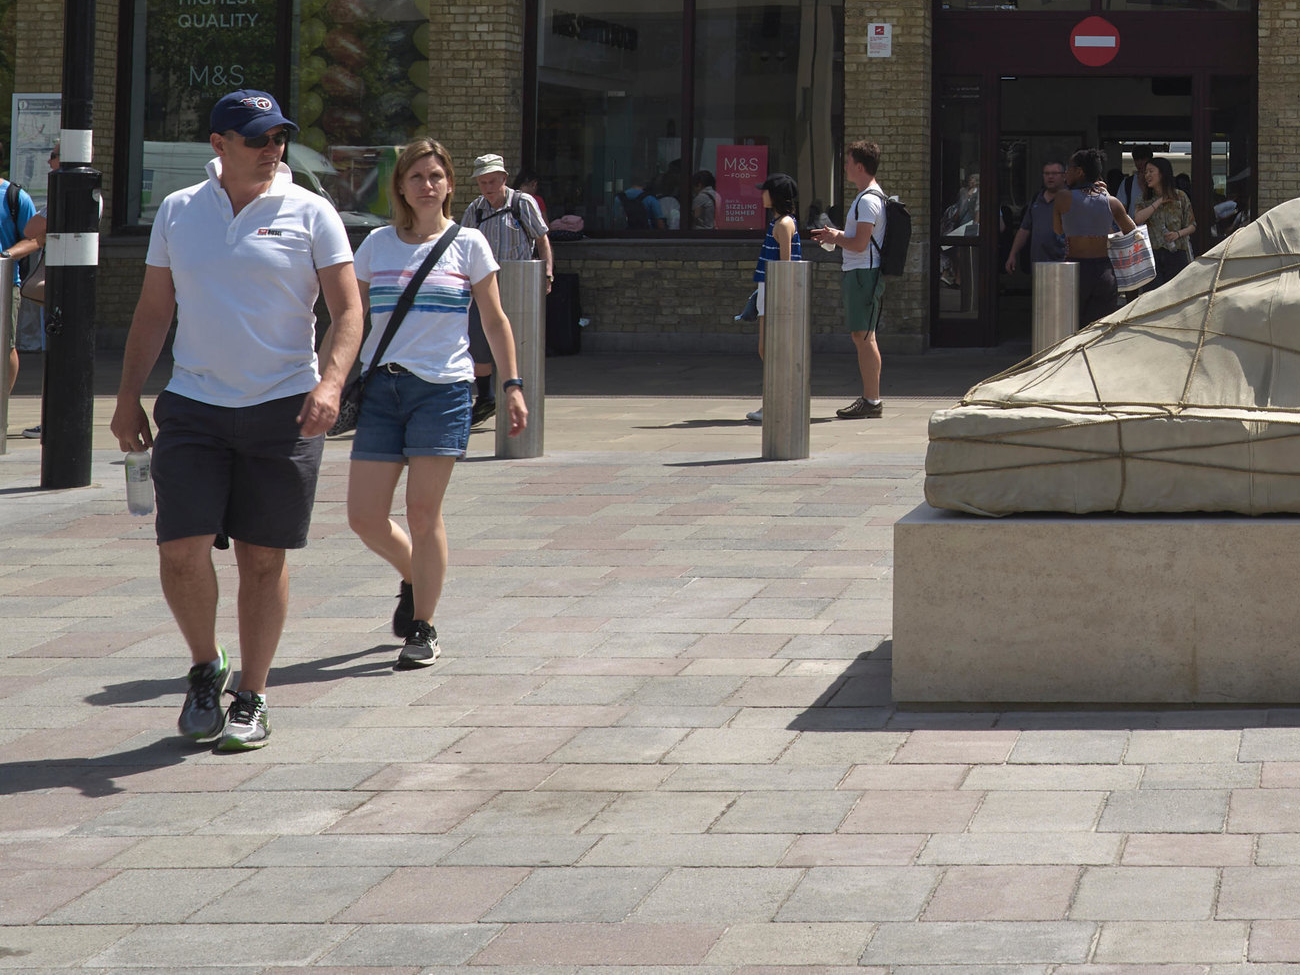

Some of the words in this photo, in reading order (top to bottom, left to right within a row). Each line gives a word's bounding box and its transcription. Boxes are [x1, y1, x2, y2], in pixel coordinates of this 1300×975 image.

[178, 13, 259, 28] QUALITY
[189, 64, 245, 86] M&S
[724, 157, 759, 171] M&S
